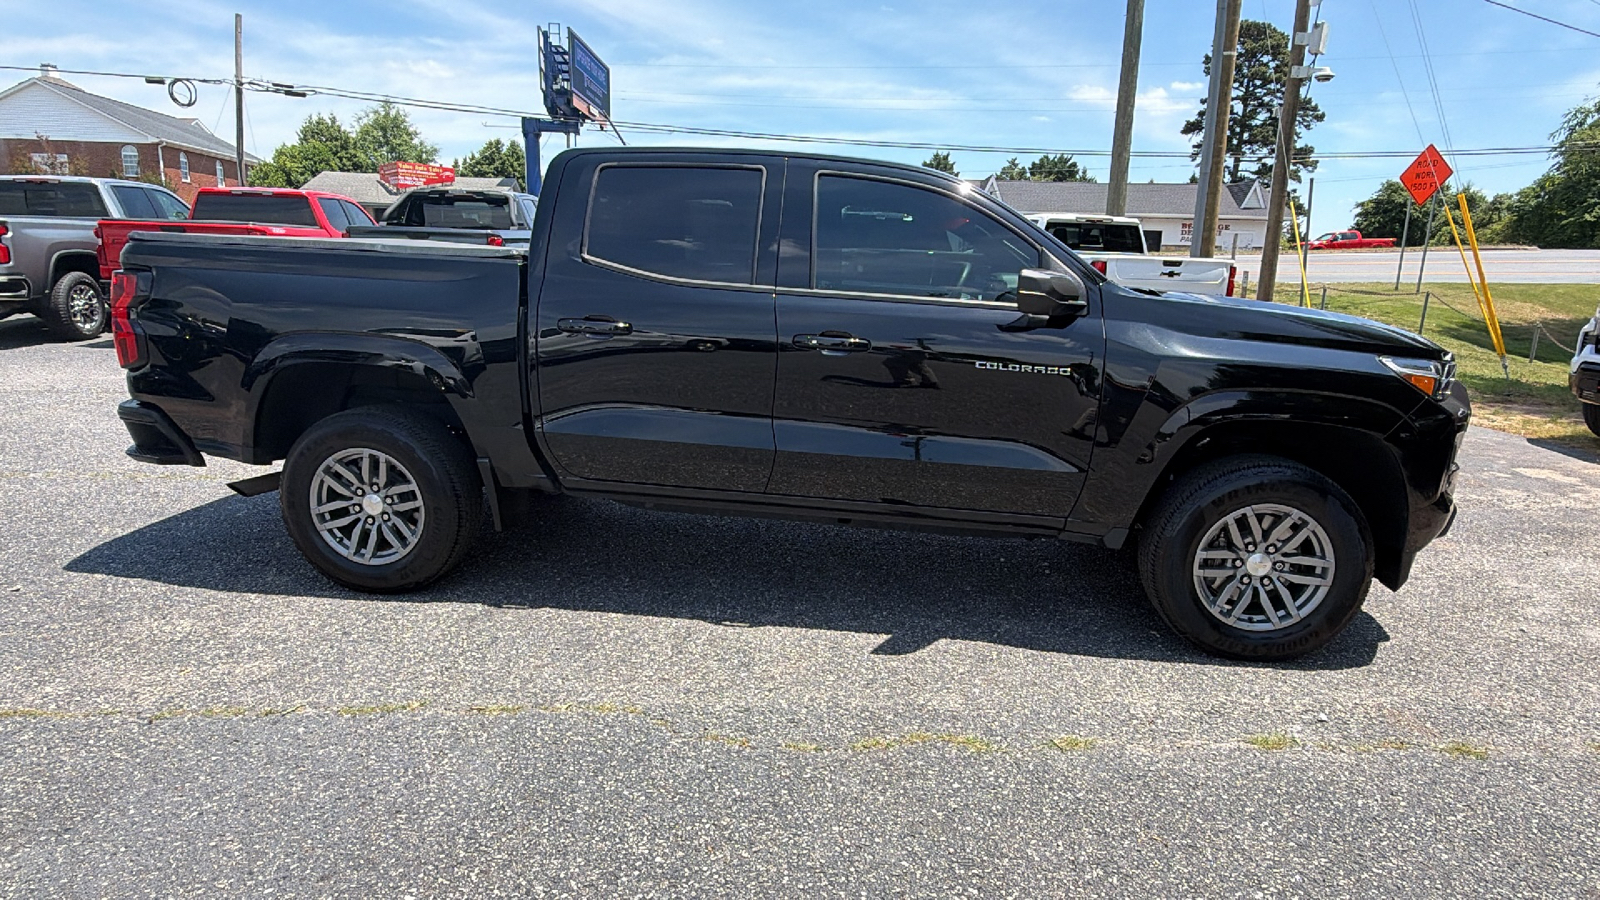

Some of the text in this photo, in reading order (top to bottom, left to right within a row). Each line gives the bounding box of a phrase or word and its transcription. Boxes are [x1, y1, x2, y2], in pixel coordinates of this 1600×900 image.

[1416, 159, 1439, 169] ROAD
[1415, 171, 1437, 180] WORK
[1410, 183, 1428, 192] 1500
[974, 360, 1072, 376] COLORADO
